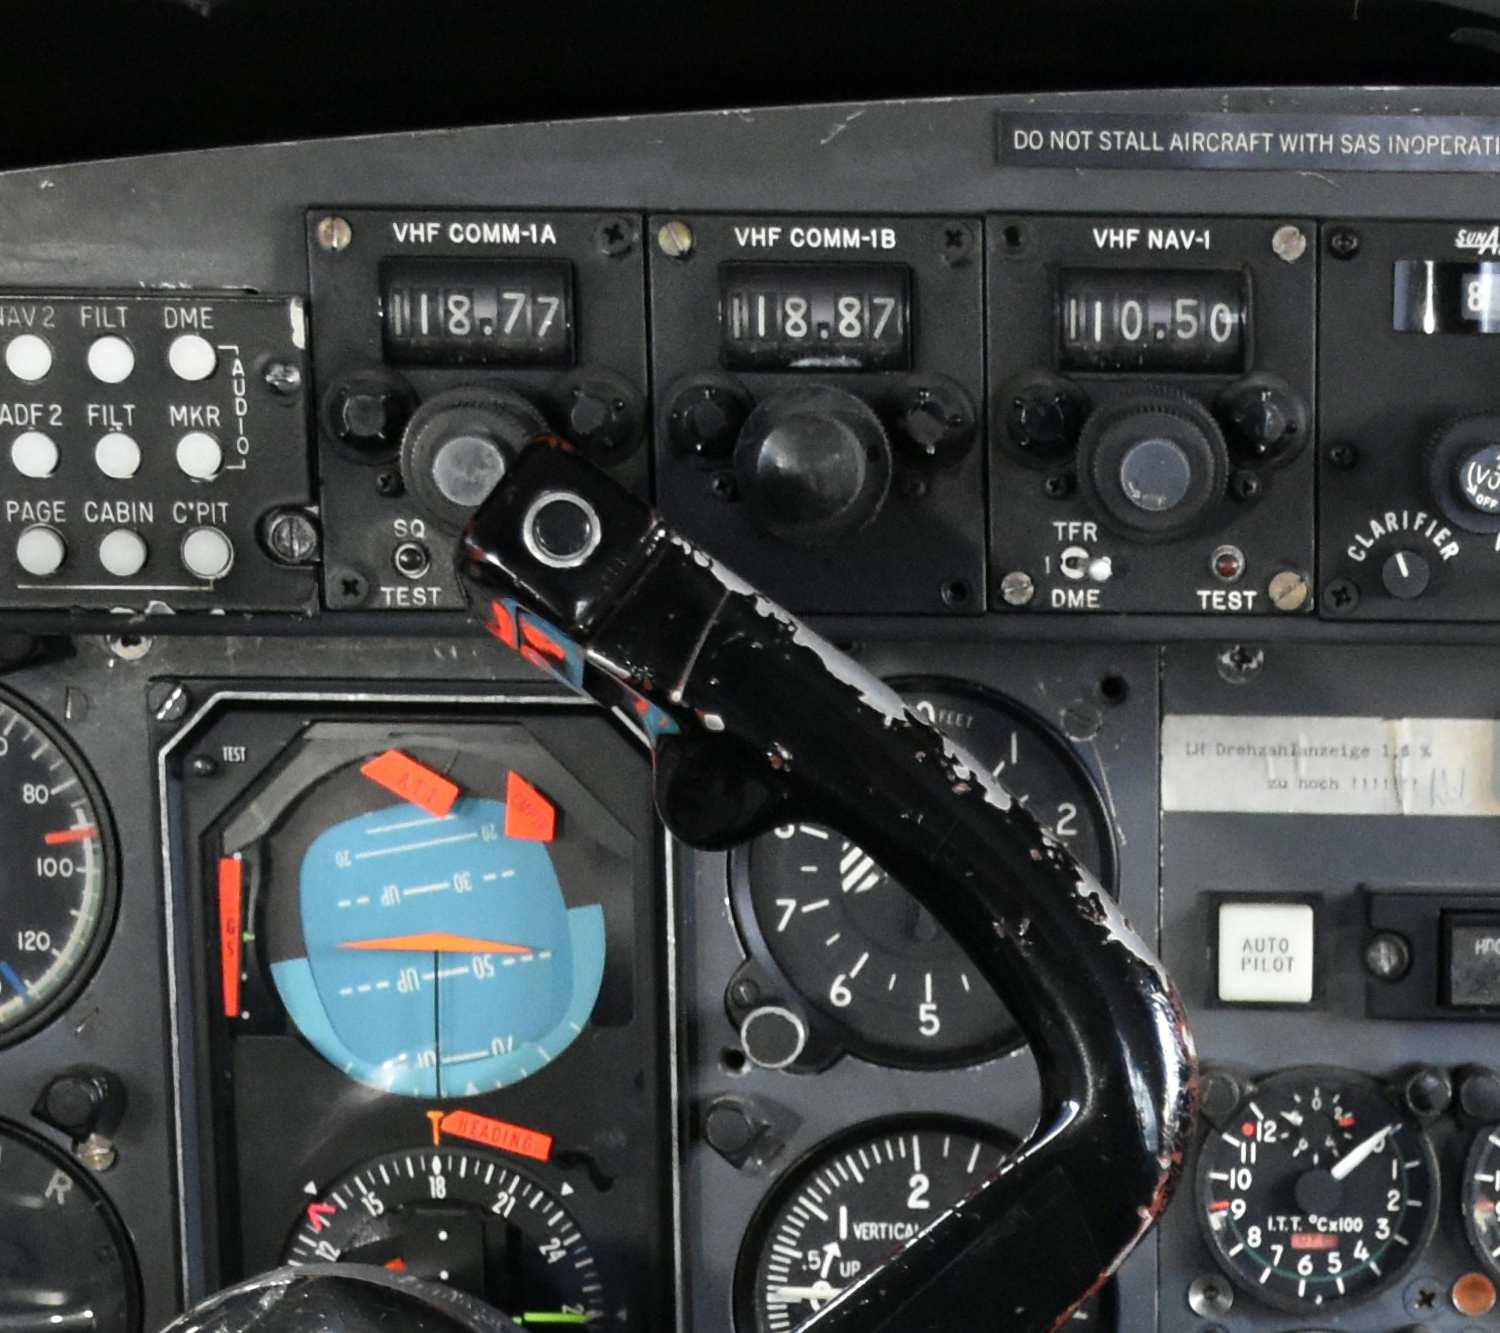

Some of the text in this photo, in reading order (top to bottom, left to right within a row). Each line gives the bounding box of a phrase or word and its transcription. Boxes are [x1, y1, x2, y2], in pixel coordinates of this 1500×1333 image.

[1013, 129, 1044, 151] DO
[1050, 129, 1094, 151] NOT
[1099, 130, 1165, 152] STALL
[1169, 131, 1274, 153] AIRCRAFT
[1279, 132, 1334, 153] WITH
[1340, 133, 1381, 155] SAS
[392, 222, 557, 244] VHF COMM-1A
[734, 226, 897, 249] VHF COMM-1B
[1092, 228, 1210, 250] VHF NAV-1
[79, 305, 129, 329] FILT
[163, 306, 214, 330] DME
[169, 404, 221, 427] MKR
[5, 499, 66, 523] PAGE
[83, 500, 154, 524] CABIN
[1348, 510, 1460, 562] CLARIFIER
[380, 586, 442, 607] TEST
[1196, 589, 1258, 611] TEST
[36, 857, 74, 878] 100
[1241, 936, 1290, 955] AUTO
[1240, 956, 1294, 973] PILOT
